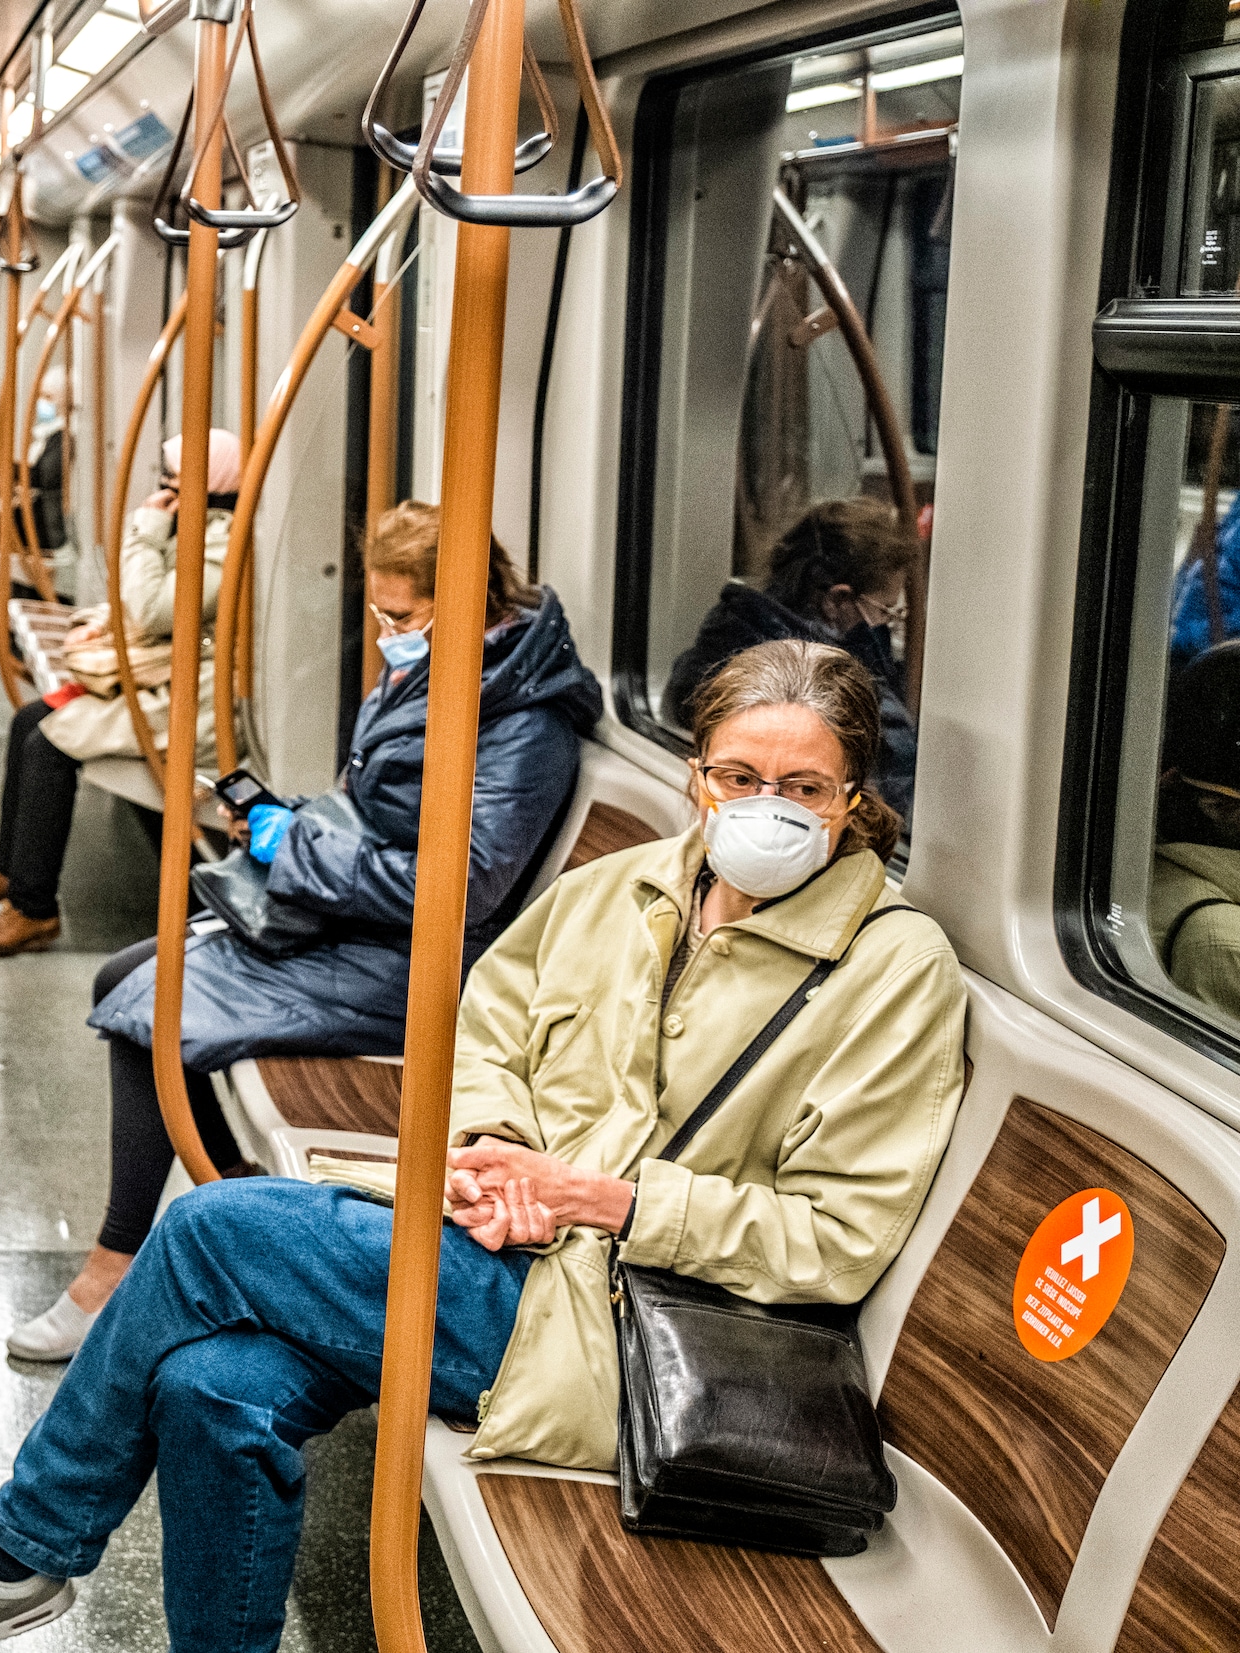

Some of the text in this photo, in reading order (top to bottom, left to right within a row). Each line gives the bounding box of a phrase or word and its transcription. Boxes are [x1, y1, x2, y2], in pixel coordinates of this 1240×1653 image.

[1035, 1277, 1044, 1289] CE
[1045, 1265, 1087, 1304] VEUILLEZ LAISSER
[1025, 1294, 1041, 1310] DEZE
[1060, 1323, 1075, 1338] NIET
